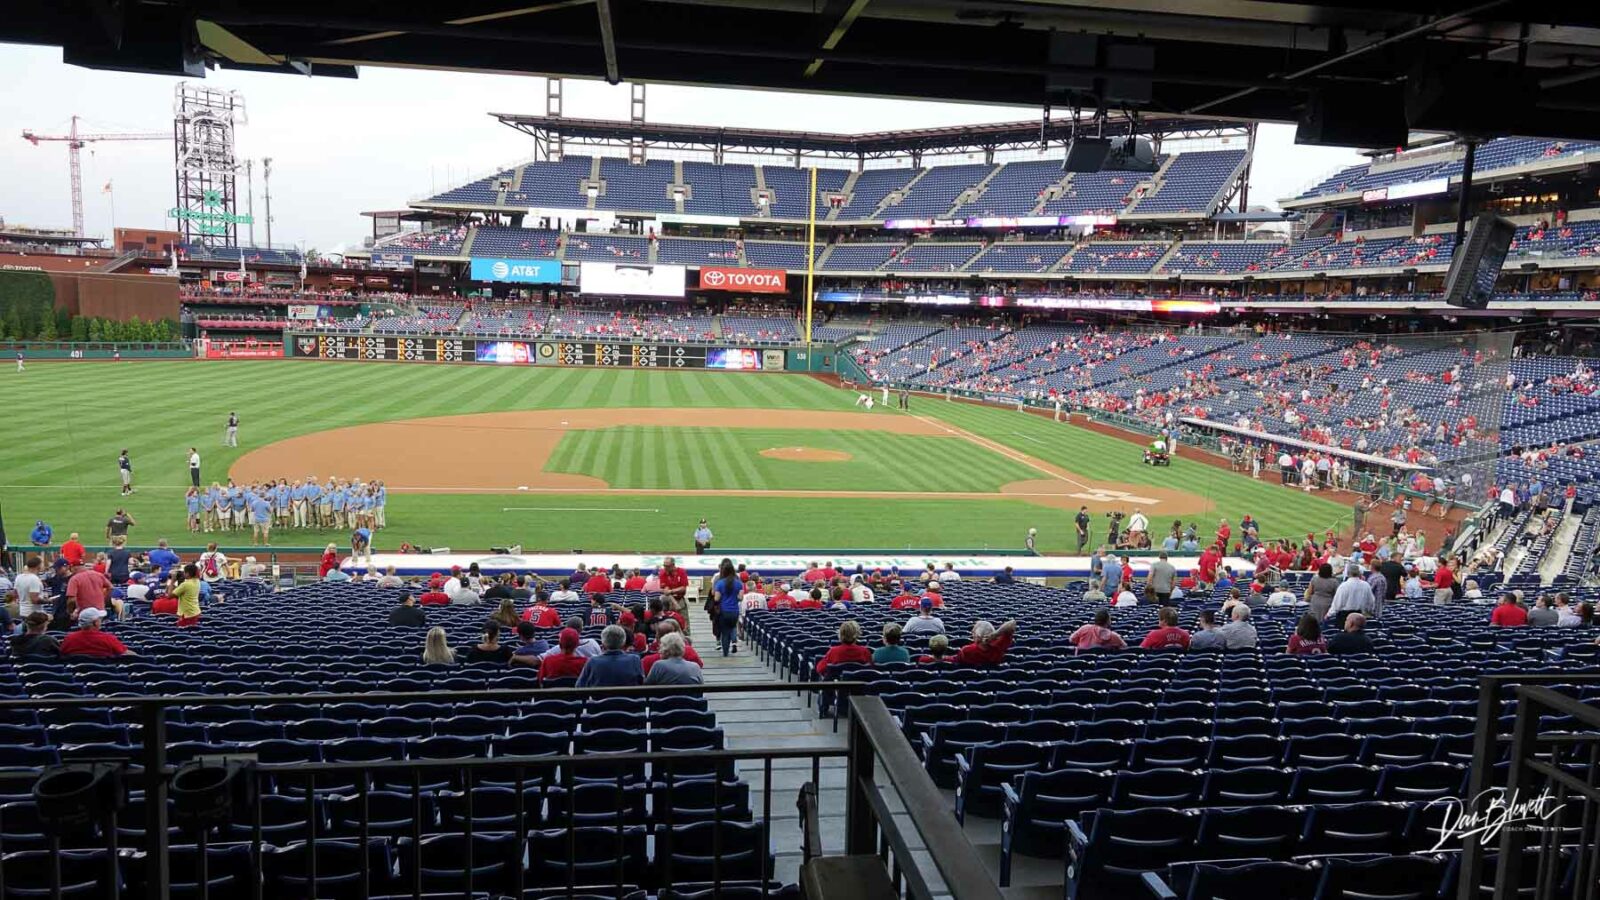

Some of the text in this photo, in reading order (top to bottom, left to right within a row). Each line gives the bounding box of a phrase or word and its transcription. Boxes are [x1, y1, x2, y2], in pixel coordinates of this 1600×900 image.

[511, 265, 541, 277] AT&T
[727, 273, 782, 287] TOYOTA
[70, 350, 83, 358] 401
[863, 590, 870, 599] 5
[530, 611, 542, 624] 5
[590, 613, 607, 626] 10
